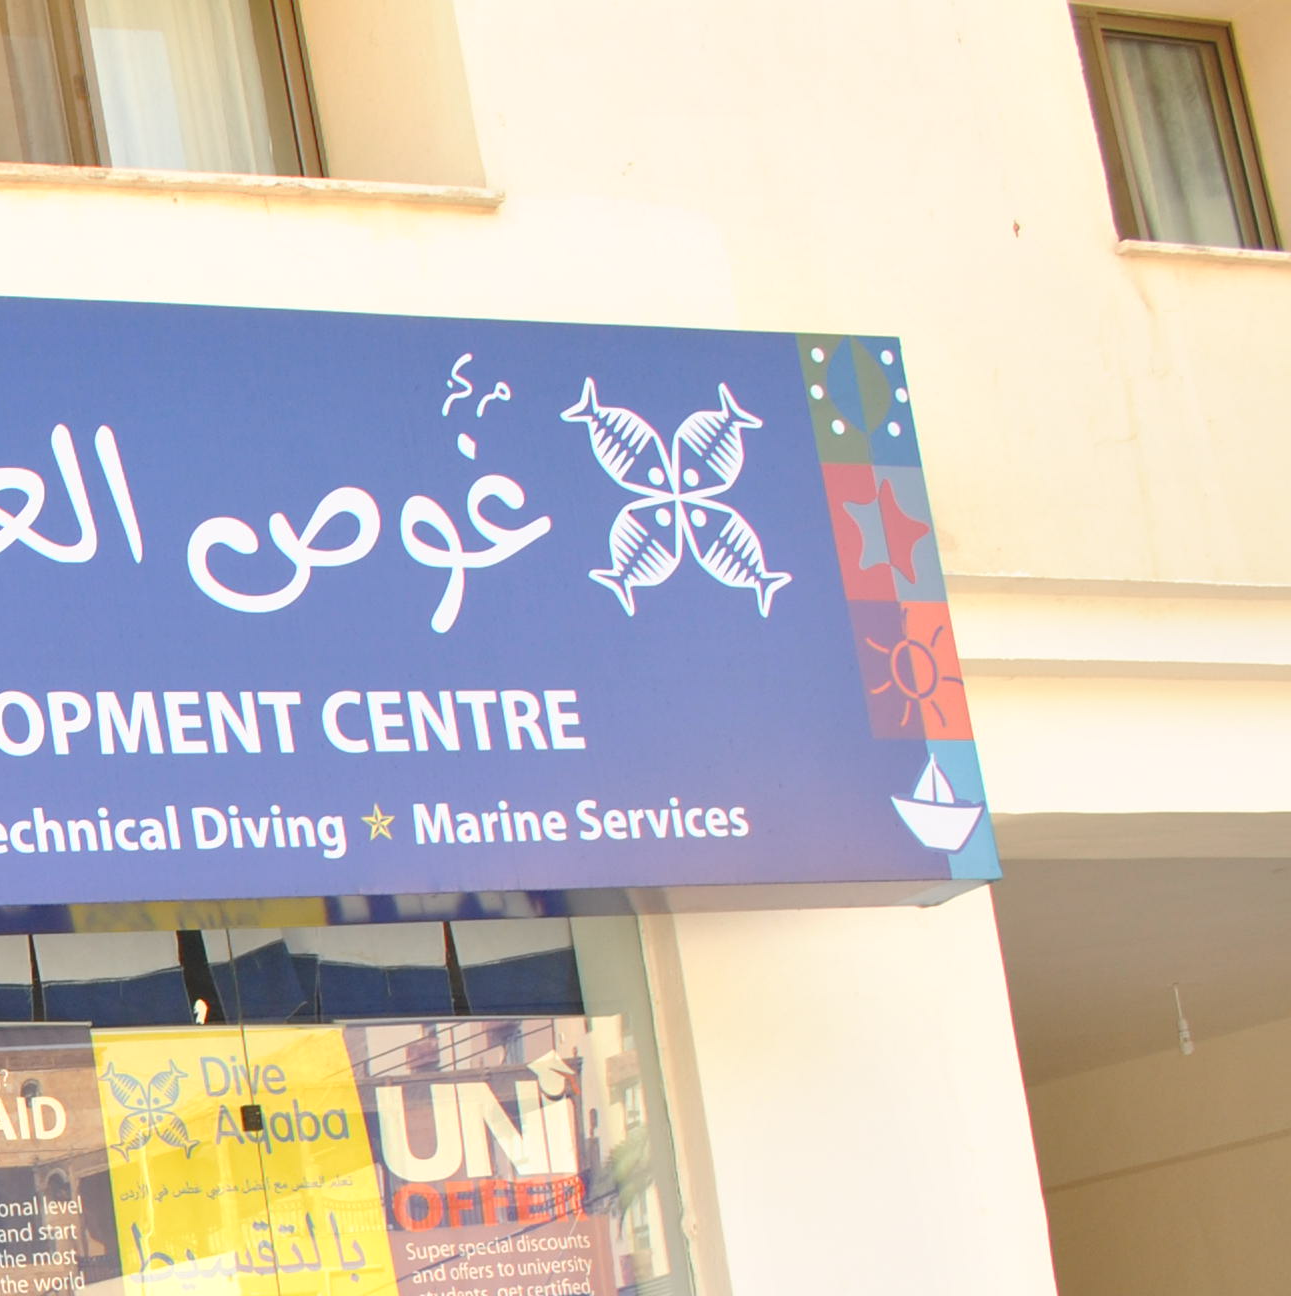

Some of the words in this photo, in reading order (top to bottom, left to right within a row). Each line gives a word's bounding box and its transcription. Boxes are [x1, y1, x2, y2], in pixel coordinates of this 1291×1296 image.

[441, 352, 511, 418] مركز
[187, 430, 551, 633] غوص
[323, 690, 586, 753] CENTRE
[192, 805, 346, 859] Diving
[413, 800, 567, 844] Marine
[576, 797, 749, 841] Services
[200, 1056, 287, 1097] Dive
[216, 1099, 349, 1154] Aqaba
[43, 1196, 83, 1215] level
[392, 1176, 587, 1232] OFFER
[38, 1222, 77, 1241] start
[406, 1242, 455, 1264] Super
[458, 1236, 513, 1260] special
[516, 1234, 590, 1253] discounts
[32, 1248, 77, 1267] most
[412, 1265, 446, 1284] and
[449, 1262, 495, 1281] offers
[497, 1262, 515, 1278] to
[517, 1255, 592, 1280] university
[0, 1274, 29, 1294] the
[33, 1271, 85, 1292] world
